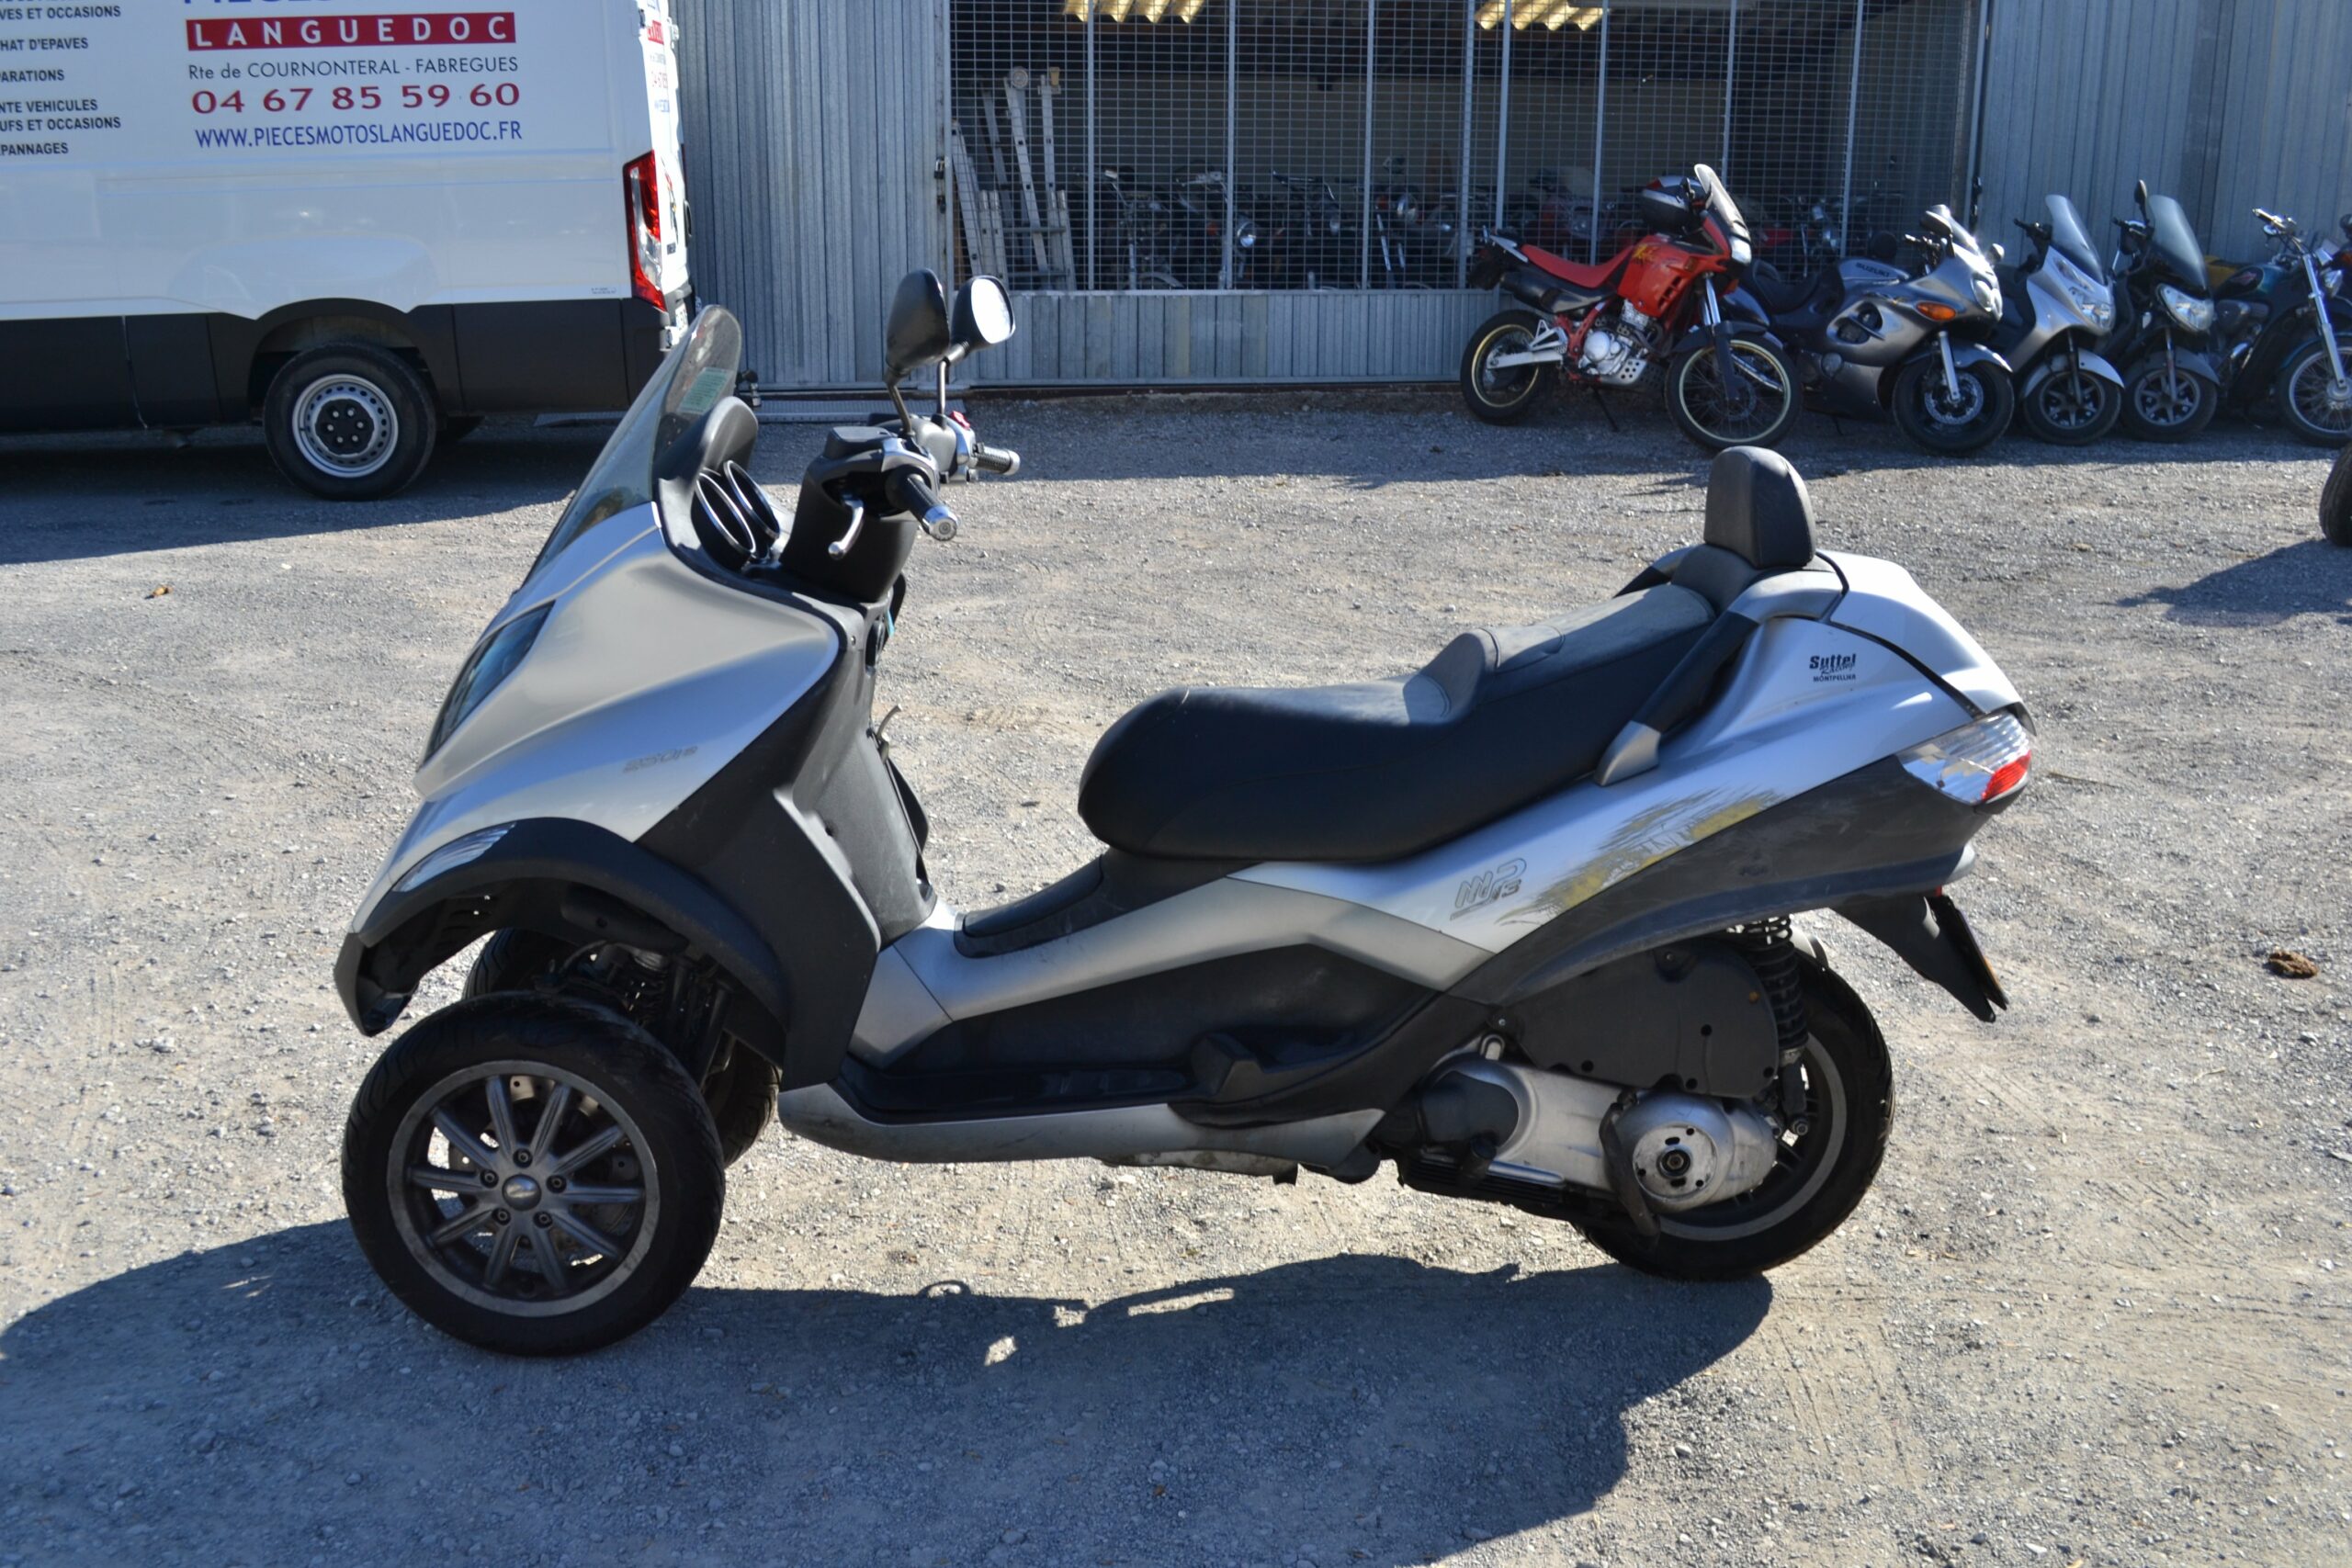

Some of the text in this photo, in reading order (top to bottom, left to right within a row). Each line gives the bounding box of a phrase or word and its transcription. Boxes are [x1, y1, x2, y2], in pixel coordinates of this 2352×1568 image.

[27, 7, 43, 19] ET
[47, 6, 121, 18] OCCASIONS
[194, 16, 506, 47] LANGUEDOC
[29, 37, 89, 51] D'EPAVES
[188, 64, 214, 79] Rte
[220, 62, 241, 79] de
[247, 59, 401, 78] COURNONTERAL
[415, 56, 518, 73] FABREGUES
[0, 69, 65, 83] ARATIONS
[26, 98, 98, 113] VEHICULES
[191, 82, 520, 115] 04 67 85 59 60
[27, 118, 43, 131] ET
[47, 117, 121, 130] OCCASIONS
[195, 120, 522, 148] WWW.PIECESMOTOSLANGUEDOC.FR
[0, 142, 69, 156] PANNAGES
